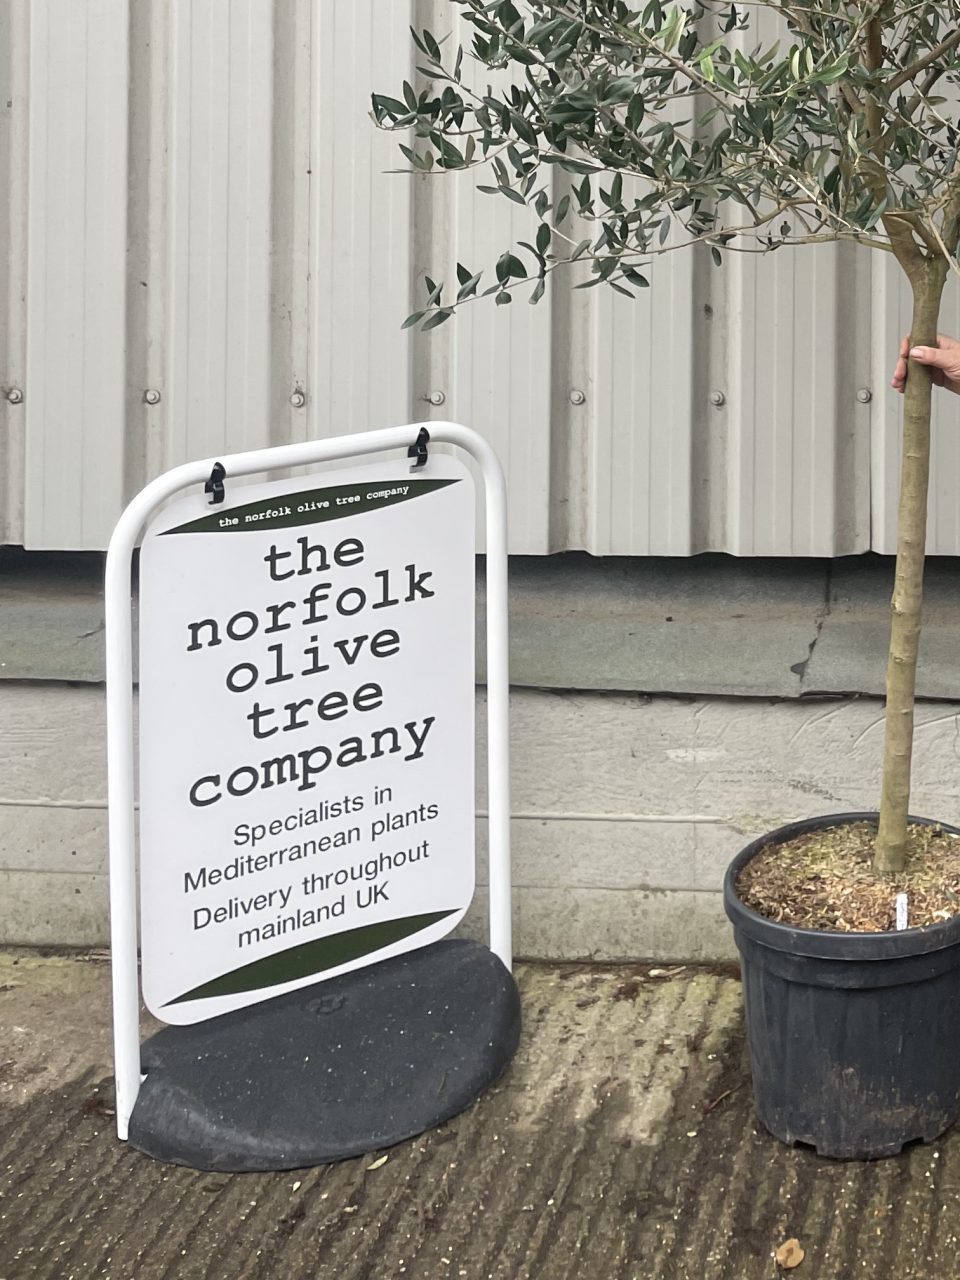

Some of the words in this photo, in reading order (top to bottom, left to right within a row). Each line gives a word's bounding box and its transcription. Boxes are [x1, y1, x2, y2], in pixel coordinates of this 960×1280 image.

[218, 517, 238, 527] the
[244, 506, 291, 522] norfolk
[297, 500, 329, 512] olive
[335, 495, 360, 505] tree
[366, 485, 409, 499] company
[263, 536, 364, 581] the
[186, 563, 434, 651] norfolk
[225, 629, 399, 692] olive
[246, 682, 382, 739] tree
[189, 716, 435, 806] company
[184, 827, 360, 892] Mediterranean
[371, 803, 438, 841] plants
[233, 795, 363, 846] Specialists
[374, 786, 391, 805] in
[193, 885, 291, 930] Delivery
[301, 840, 429, 895] throughout
[238, 894, 344, 947] mainland
[356, 881, 389, 908] UK
